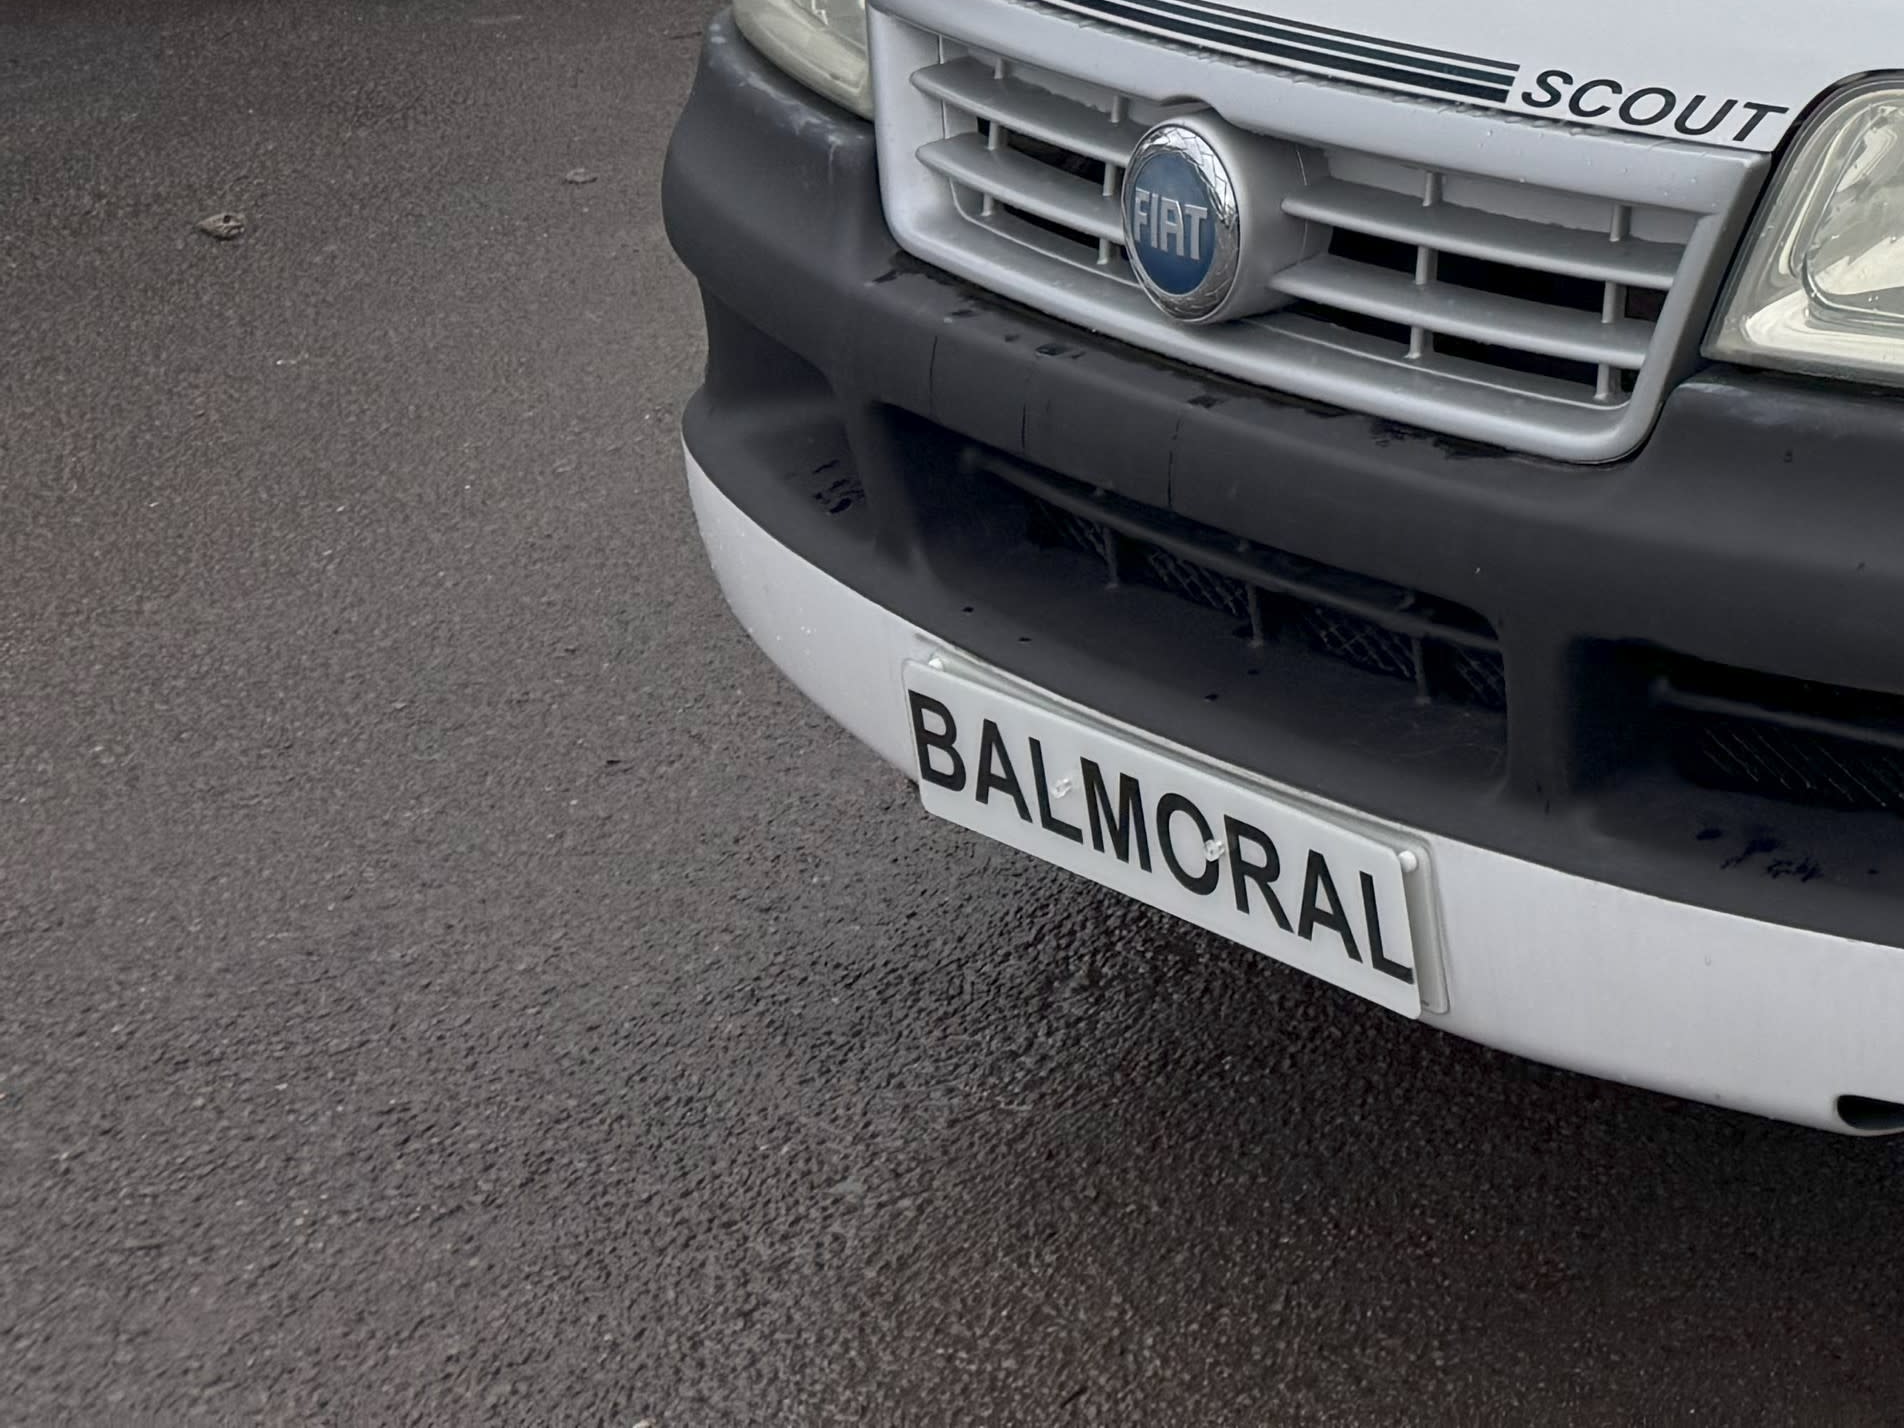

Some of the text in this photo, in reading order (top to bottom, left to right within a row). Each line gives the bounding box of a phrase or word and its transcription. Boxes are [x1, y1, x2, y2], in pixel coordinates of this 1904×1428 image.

[1521, 69, 1790, 142] SCOUT
[1133, 187, 1208, 260] FIAT
[907, 688, 1415, 986] BALMORAL
